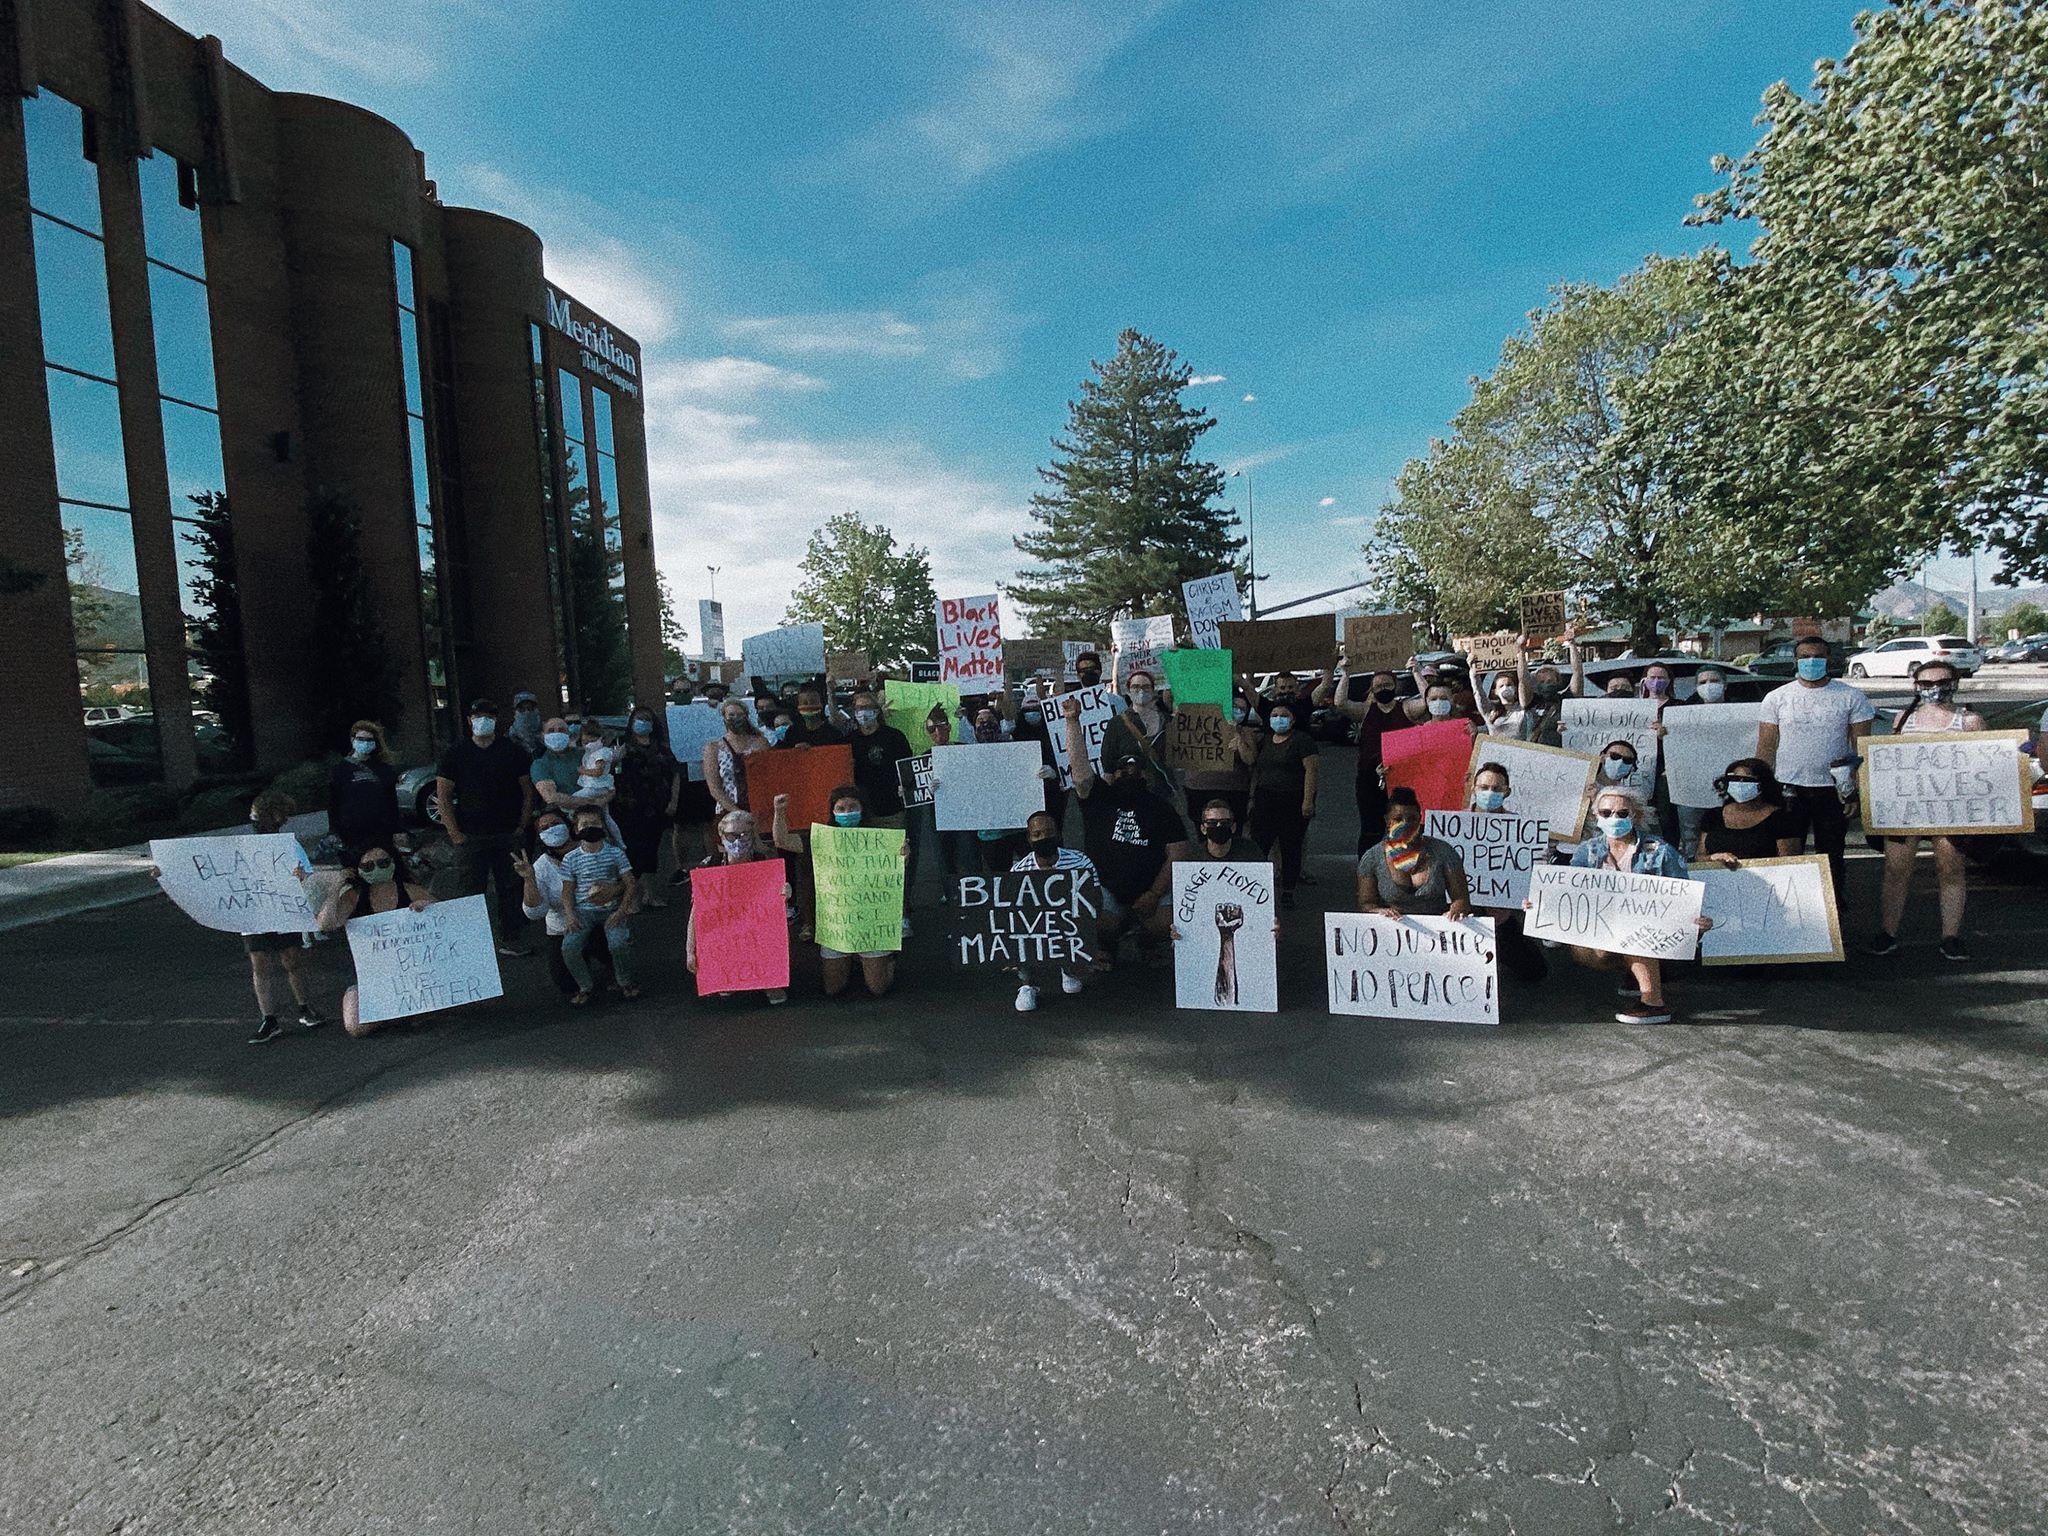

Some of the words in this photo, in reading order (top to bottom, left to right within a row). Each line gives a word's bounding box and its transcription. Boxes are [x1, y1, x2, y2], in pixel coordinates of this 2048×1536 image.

[546, 287, 637, 377] Meridian
[1188, 577, 1227, 599] CHRIST
[1522, 593, 1563, 606] BLACK
[942, 598, 999, 624] Black
[940, 624, 1002, 652] Lives
[1491, 648, 1502, 656] IS
[942, 651, 1004, 682] Matter
[1043, 687, 1108, 722] BLCK
[1177, 713, 1222, 731] BLACK
[1178, 731, 1222, 746] LIVES
[1172, 745, 1225, 761] MATTER
[1873, 744, 1969, 772] BLACK
[1895, 771, 1994, 797] LIVES
[1875, 796, 2014, 826] MATTER
[1430, 814, 1461, 838] NO
[1464, 816, 1550, 844] JUSTICE
[192, 850, 293, 881] BLACK
[1473, 844, 1544, 872] PEACE
[959, 869, 1098, 919] BLACK
[1179, 867, 1212, 923] GEORGE
[1217, 866, 1270, 905] FLOYED
[1466, 874, 1511, 899] BLM
[1538, 870, 1566, 885] WE
[1571, 872, 1600, 890] CAN
[1604, 874, 1627, 893] NO
[1630, 878, 1690, 896] LONGER
[217, 890, 311, 914] MATTER
[1535, 889, 1615, 938] LOOK
[1619, 898, 1674, 920] AWAY
[433, 915, 447, 928] TO
[989, 910, 1078, 937] LIVES
[397, 940, 461, 972] BLACK
[960, 932, 1093, 965] MATTER
[1334, 927, 1378, 957] NO
[398, 976, 482, 1012] MATTER
[1333, 969, 1378, 1005] NO
